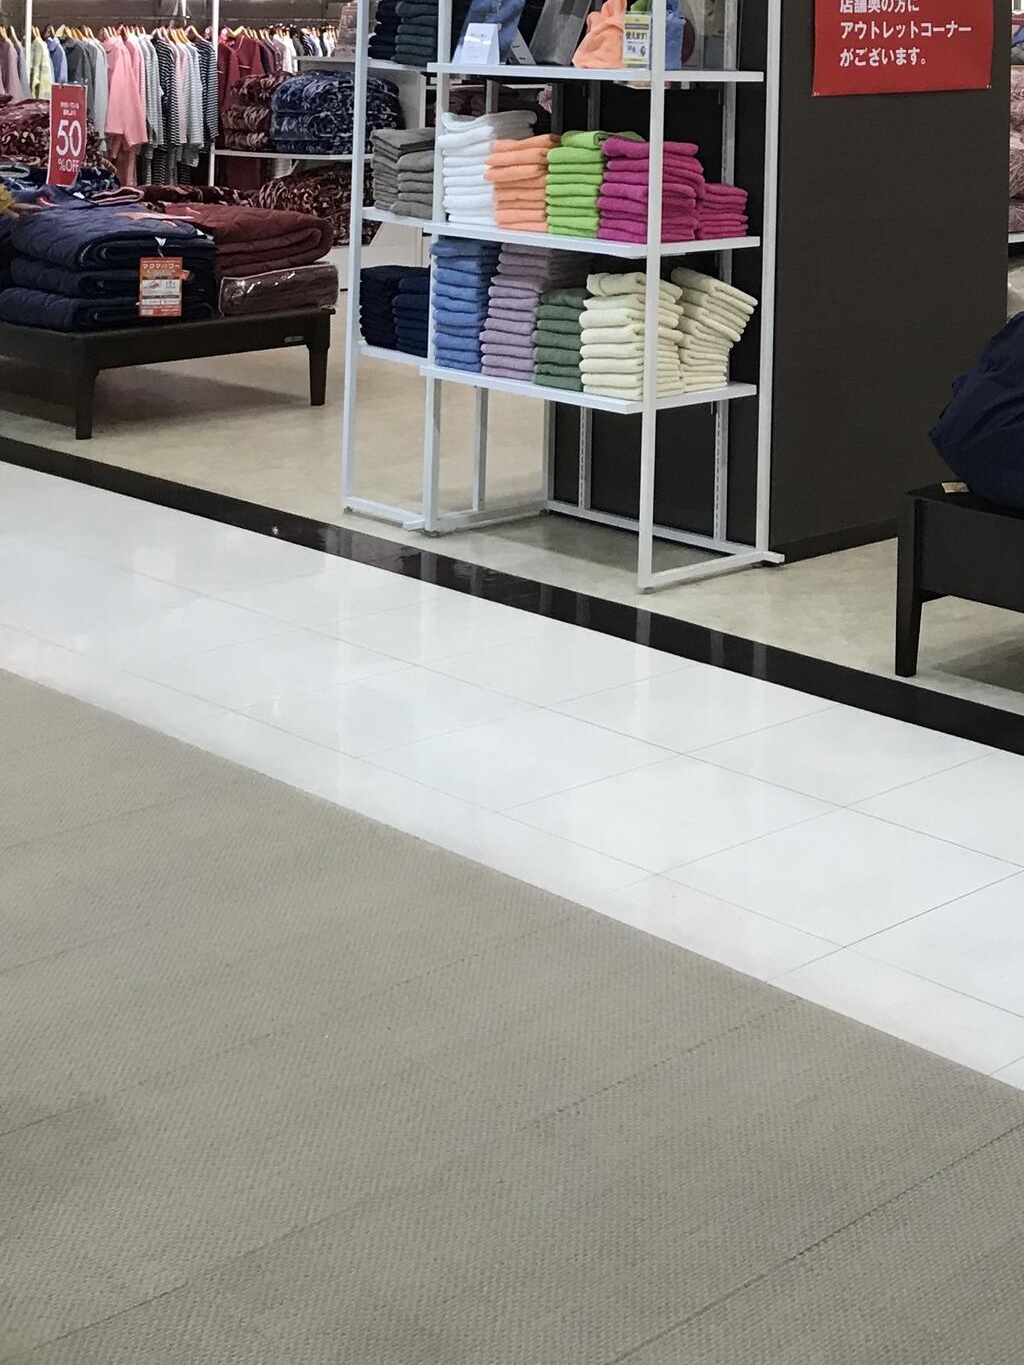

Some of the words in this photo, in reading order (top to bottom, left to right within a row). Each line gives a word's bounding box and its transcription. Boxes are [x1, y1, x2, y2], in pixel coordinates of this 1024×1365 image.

[840, 20, 972, 39] アウトレットコーナー
[840, 46, 926, 67] がございます。
[56, 119, 82, 157] 50
